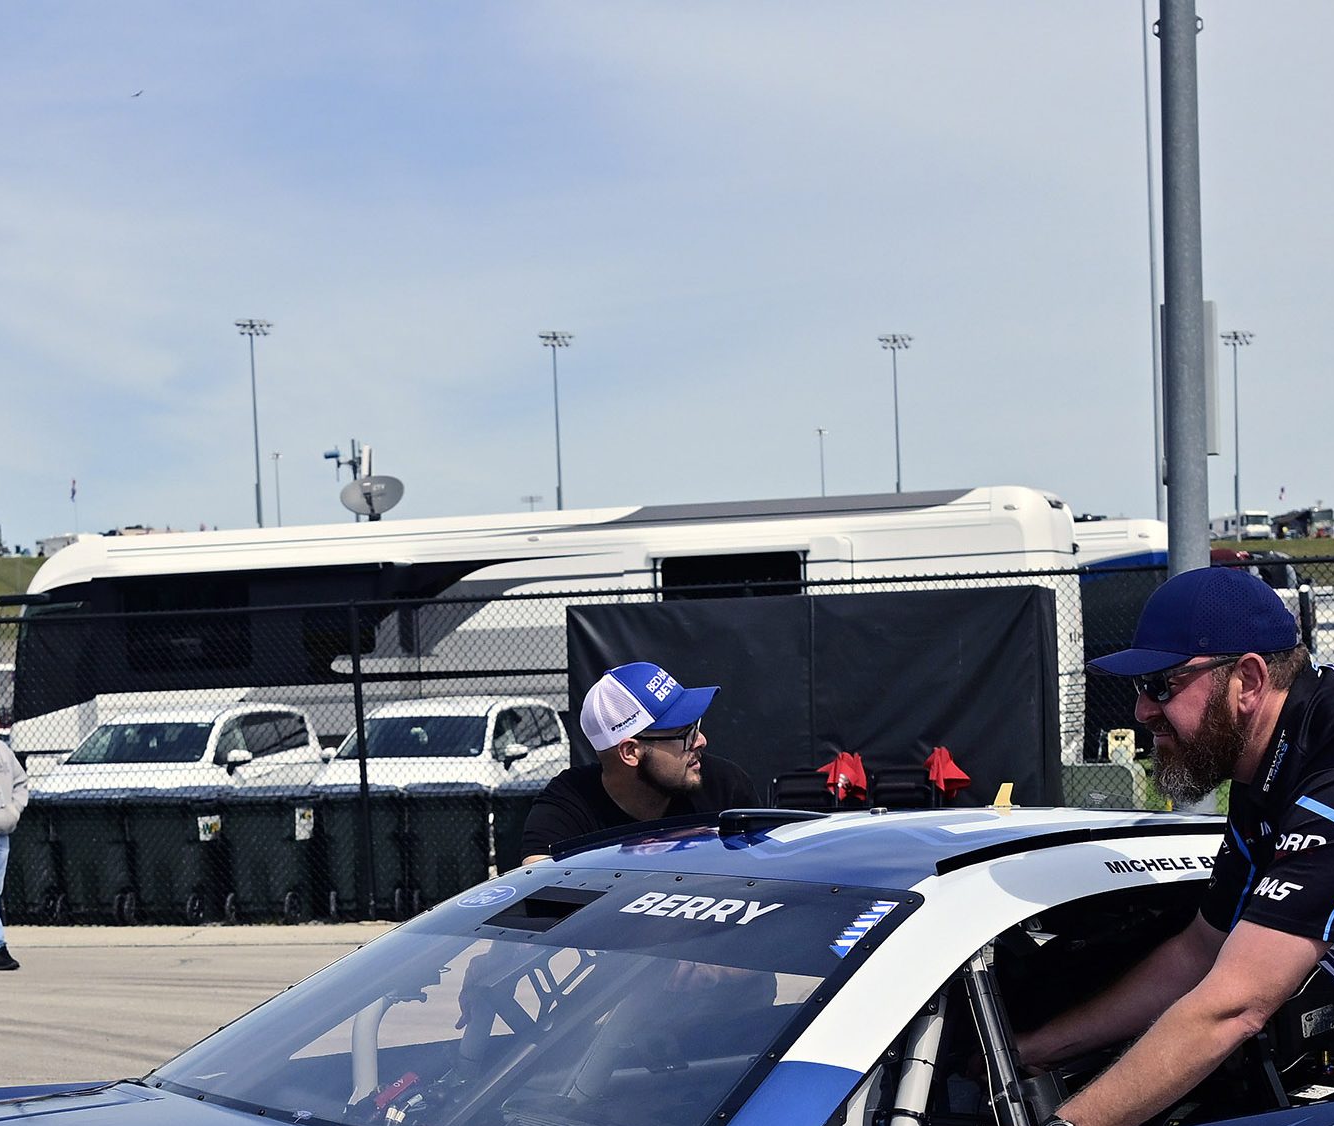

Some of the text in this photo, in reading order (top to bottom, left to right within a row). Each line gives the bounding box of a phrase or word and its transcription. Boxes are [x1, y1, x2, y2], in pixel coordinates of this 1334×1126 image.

[1262, 729, 1287, 793] STEWART
[1103, 856, 1197, 874] MICHELE
[619, 891, 784, 926] BERRY
